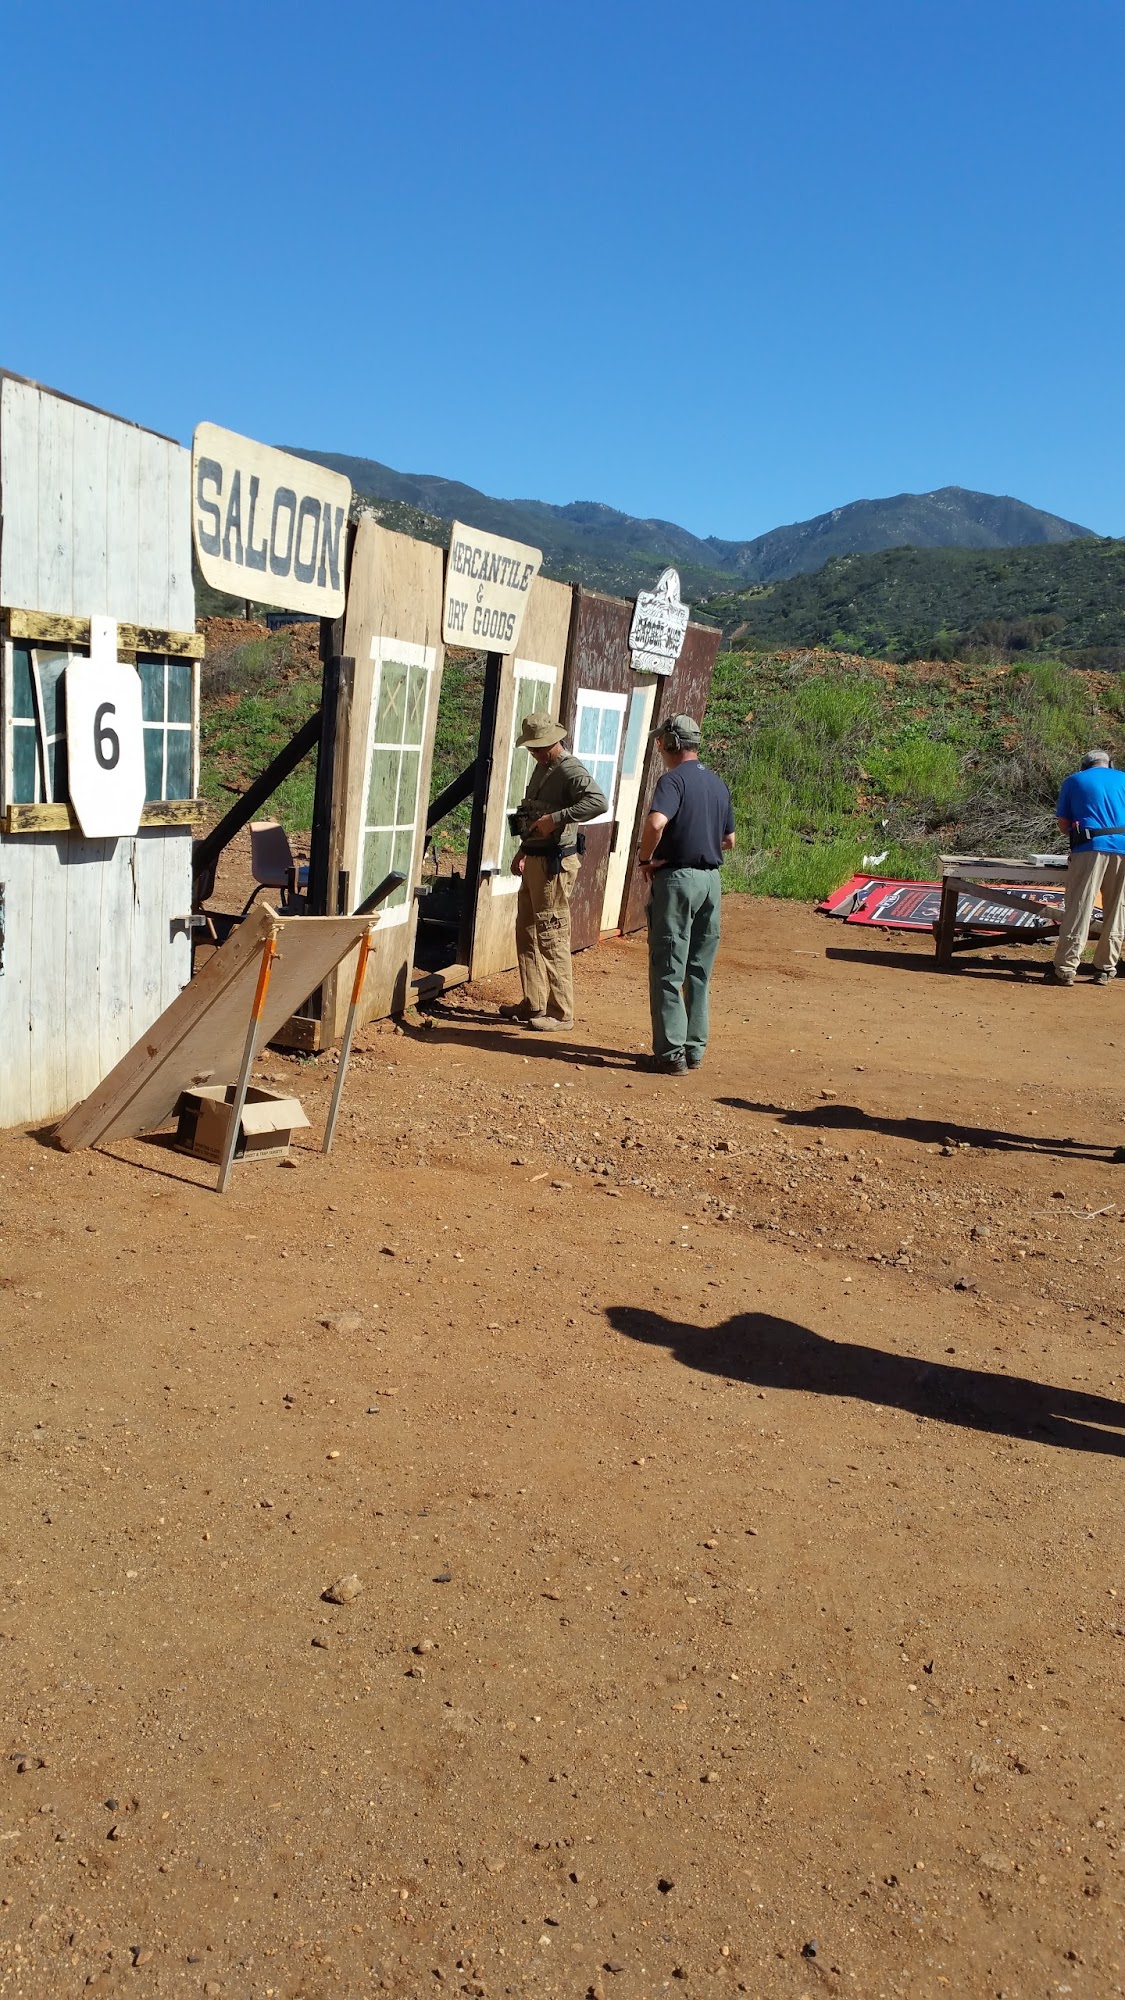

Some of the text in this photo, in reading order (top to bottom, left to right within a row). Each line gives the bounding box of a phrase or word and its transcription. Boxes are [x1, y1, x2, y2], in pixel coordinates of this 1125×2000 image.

[197, 456, 345, 591] SALOON
[450, 540, 534, 592] MERCANTILE
[447, 597, 516, 642] DRY GOODS
[476, 583, 484, 604] &
[93, 701, 120, 771] 6
